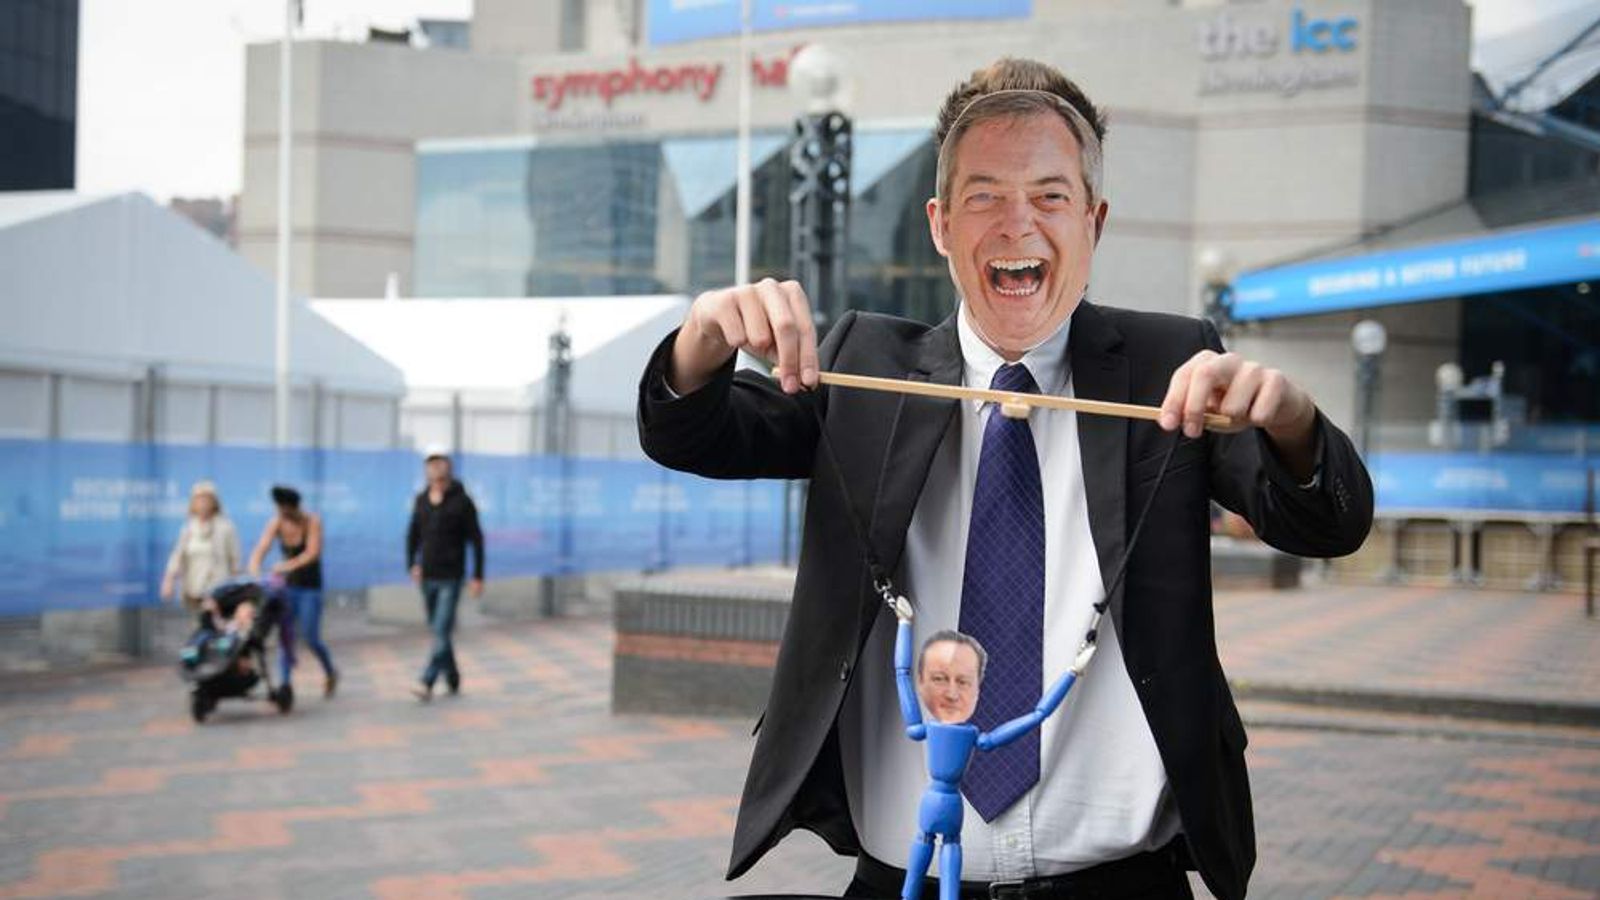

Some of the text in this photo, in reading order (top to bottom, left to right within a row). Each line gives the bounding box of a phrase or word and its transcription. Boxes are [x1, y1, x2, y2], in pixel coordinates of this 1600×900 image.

[1202, 8, 1358, 57] the icc
[532, 56, 722, 108] symphony
